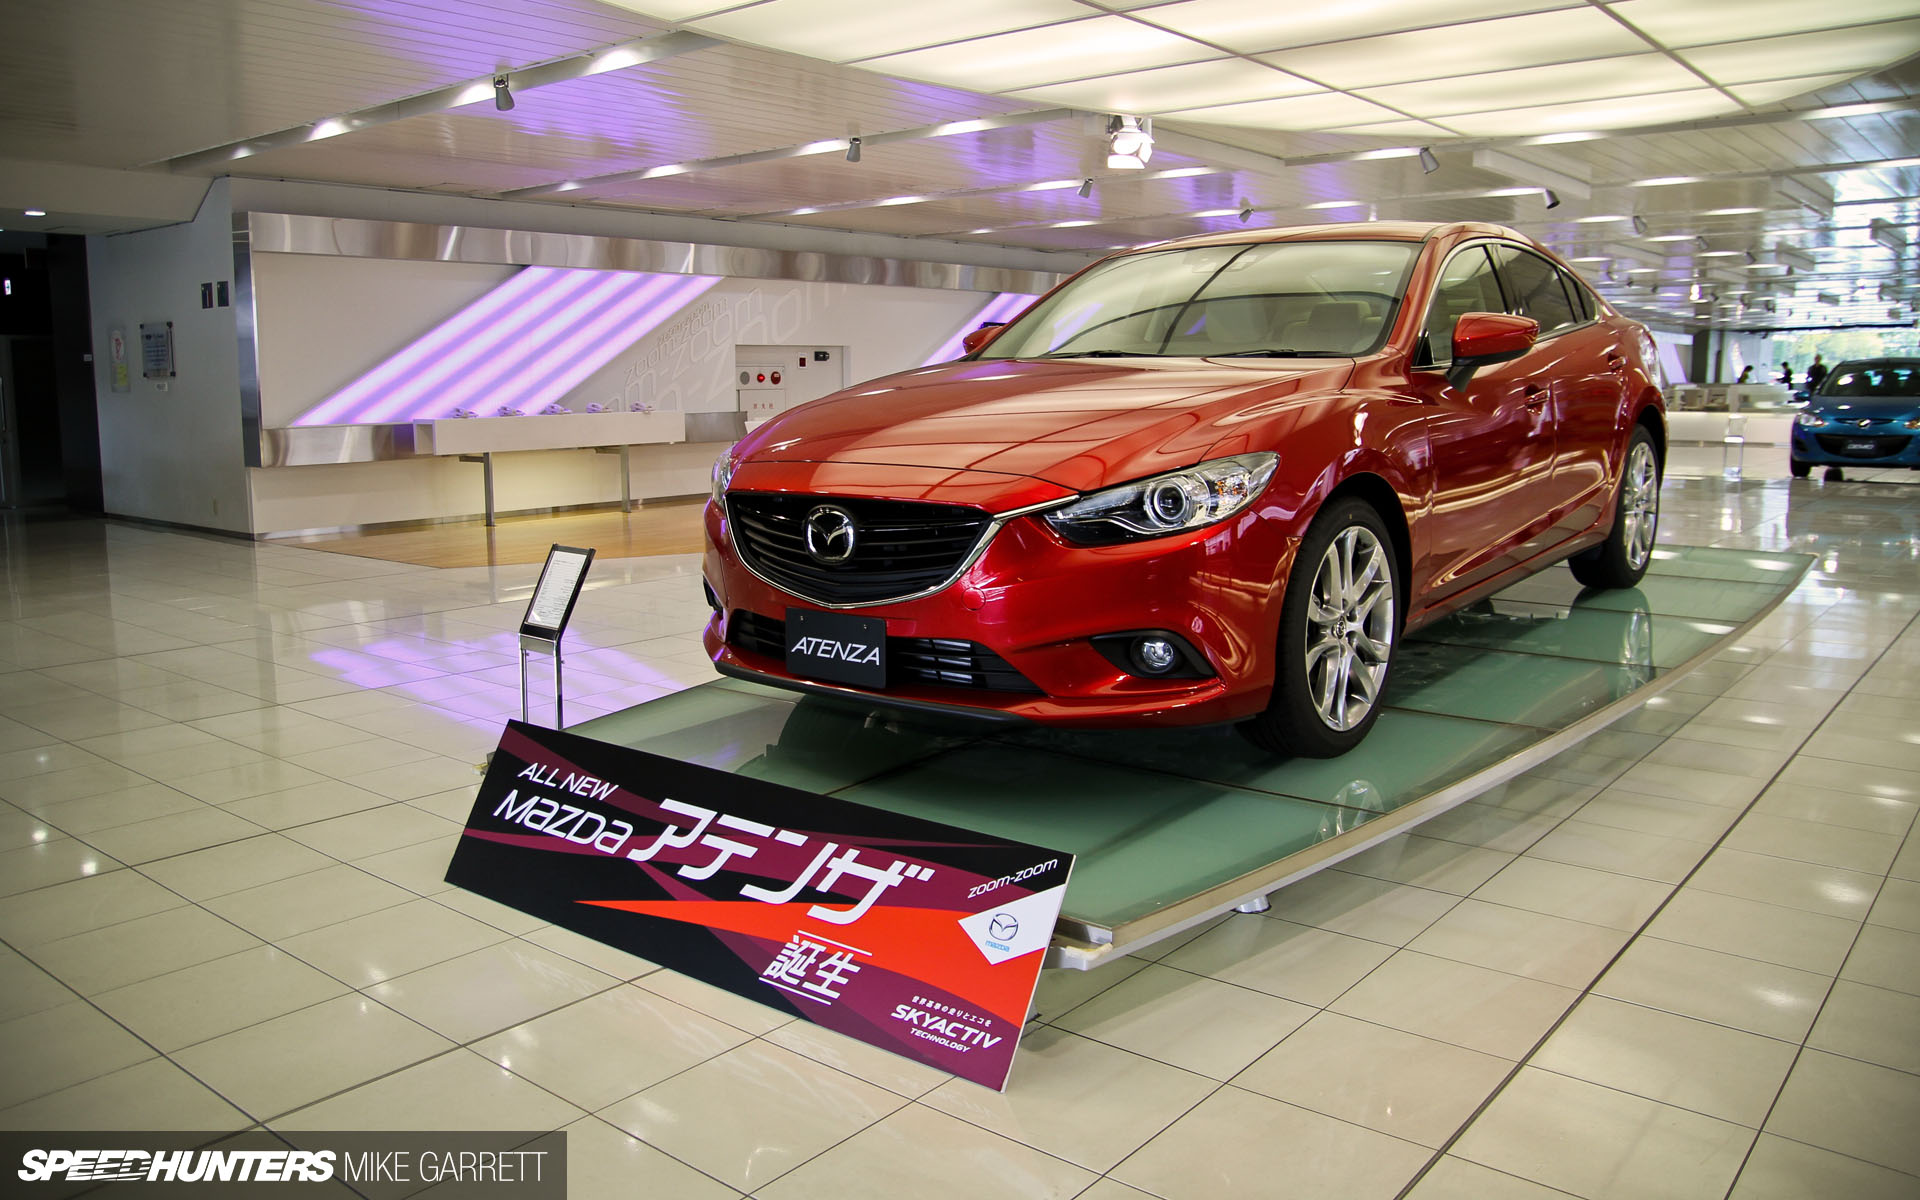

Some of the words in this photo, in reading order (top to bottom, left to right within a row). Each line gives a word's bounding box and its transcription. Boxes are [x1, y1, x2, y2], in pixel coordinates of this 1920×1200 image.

[791, 636, 880, 666] ATENZA
[517, 762, 560, 788] ALL
[559, 772, 619, 801] NEW
[627, 798, 936, 925] アテンザ
[967, 858, 1058, 899] zoom-zoom
[762, 935, 861, 1002] 誕生
[890, 1004, 1003, 1049] SKYACTIV
[910, 1027, 971, 1053] TECHNOLOGY
